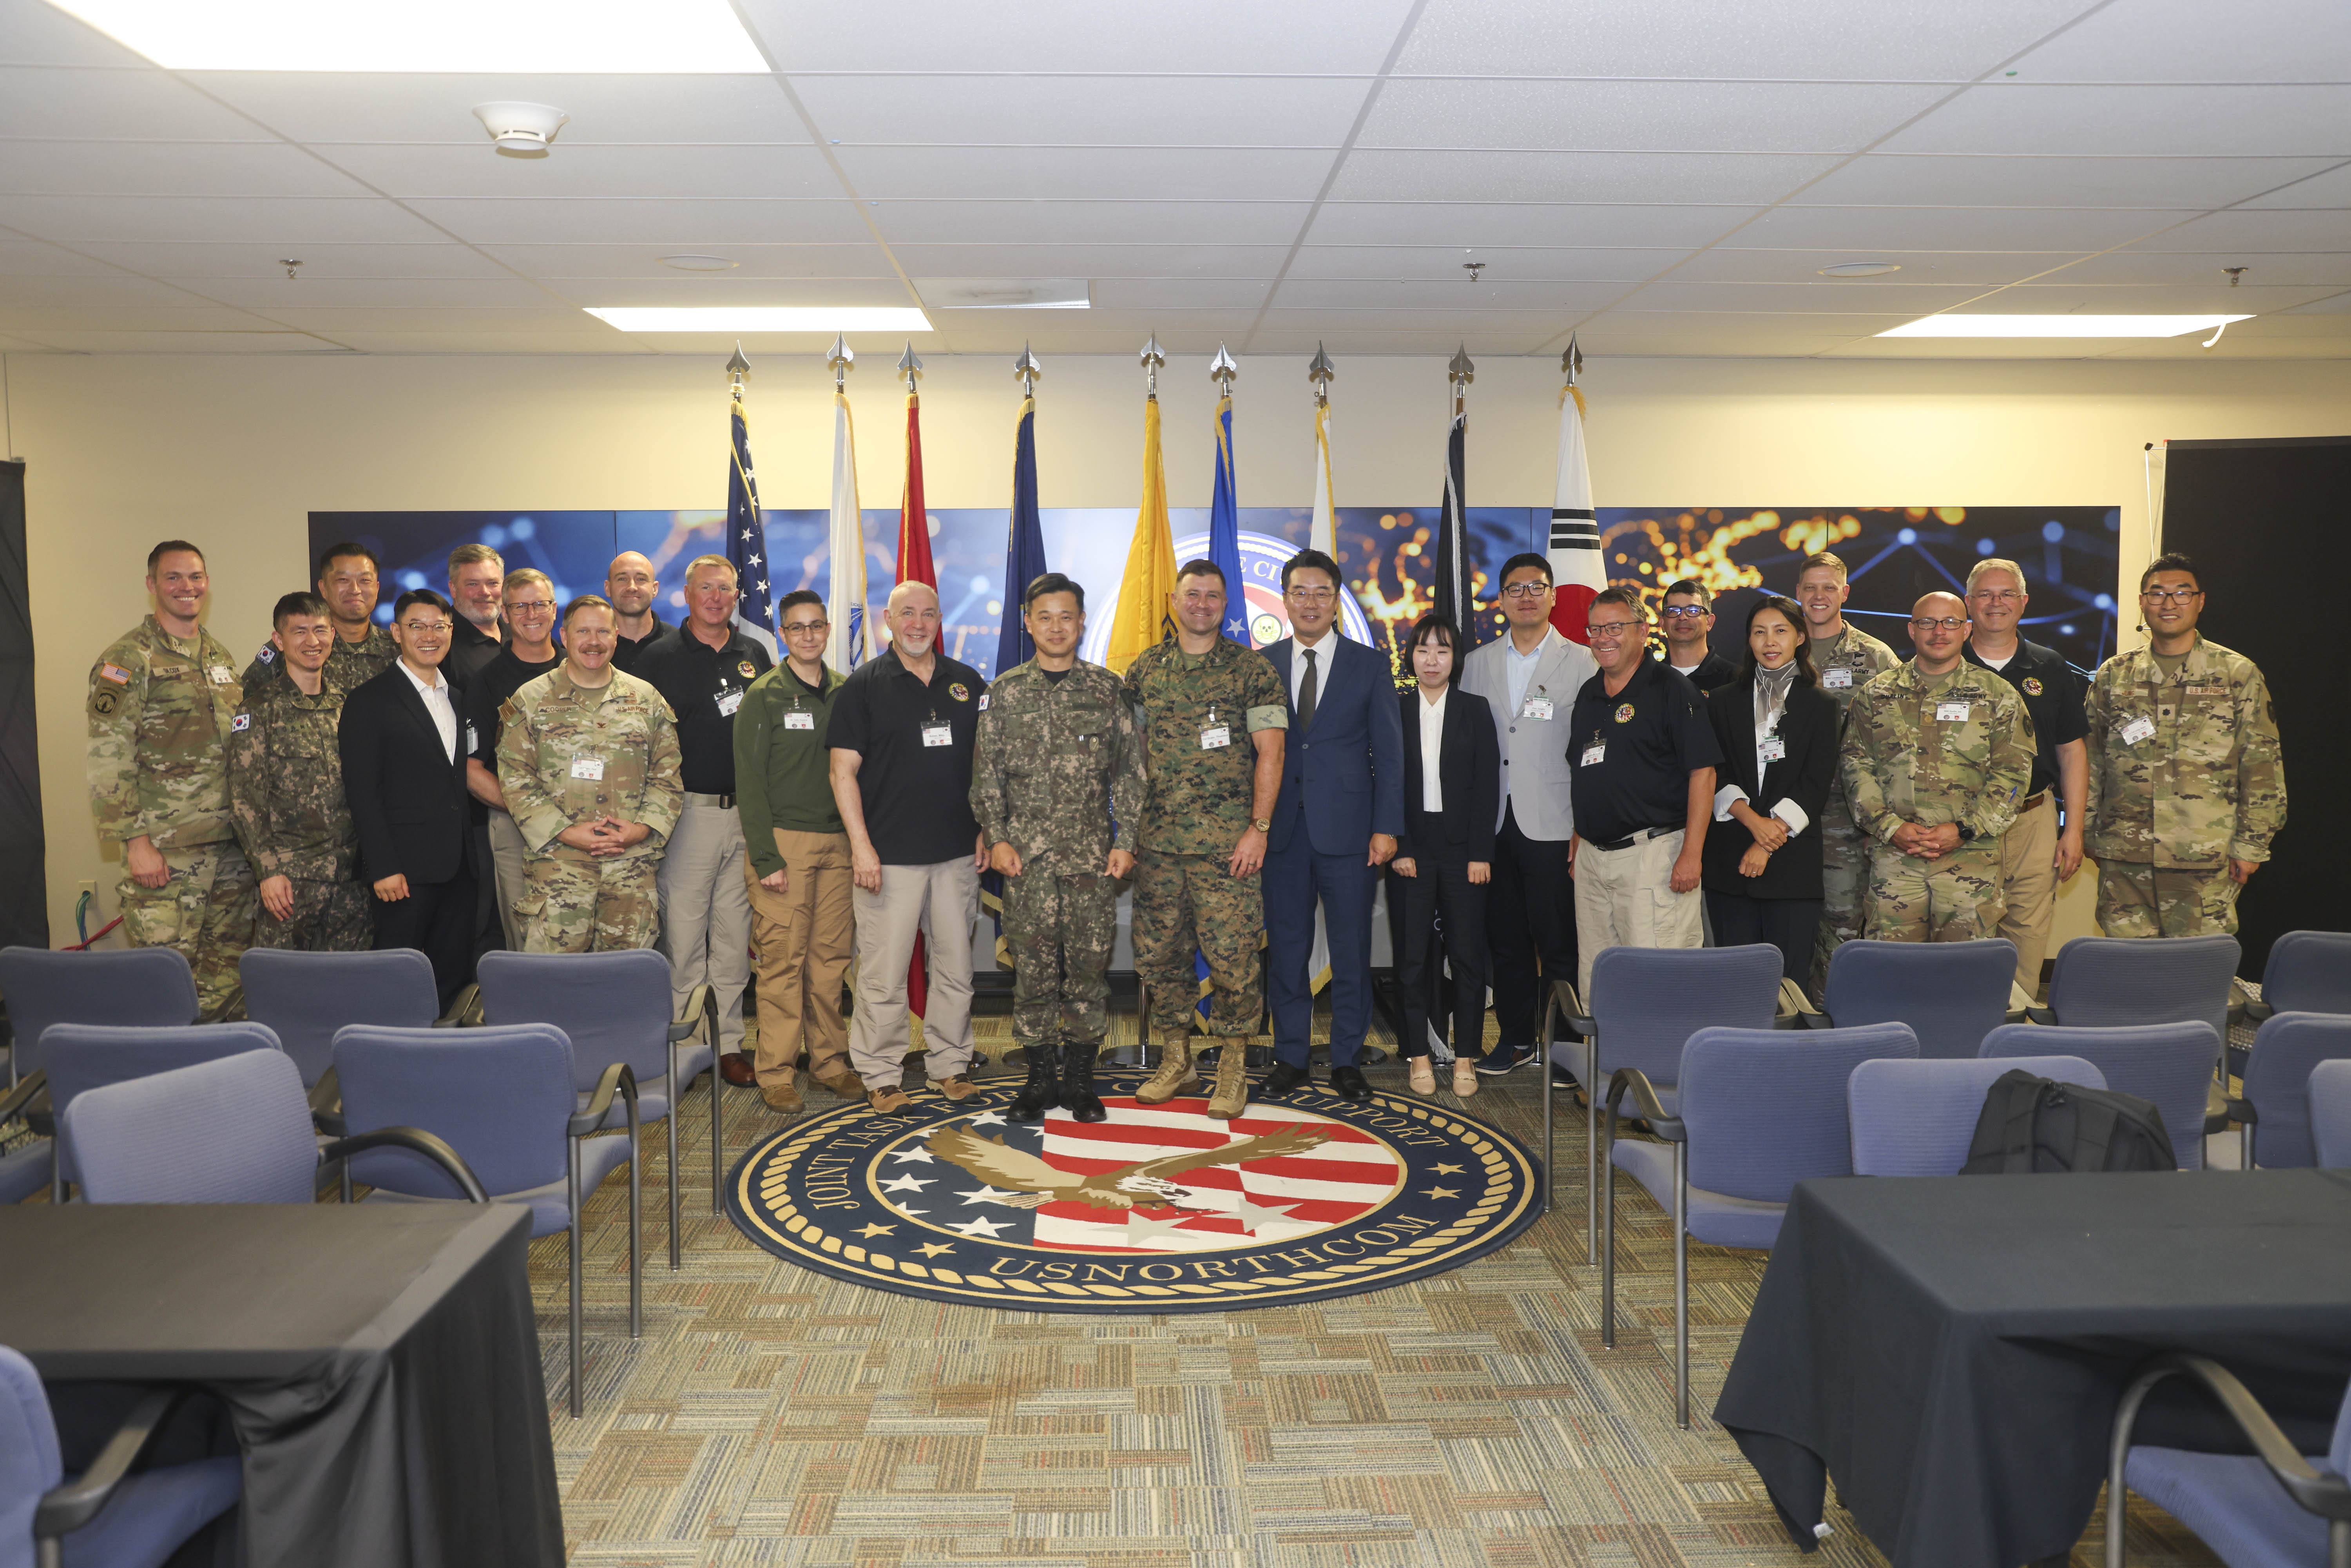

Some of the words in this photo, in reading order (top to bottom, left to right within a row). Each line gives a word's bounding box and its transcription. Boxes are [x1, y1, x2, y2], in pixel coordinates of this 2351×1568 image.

[923, 1090, 1019, 1114] FOR
[826, 1115, 934, 1149] TASK
[805, 1153, 860, 1209] JOINT
[990, 1213, 1442, 1281] USNORTHCOM
